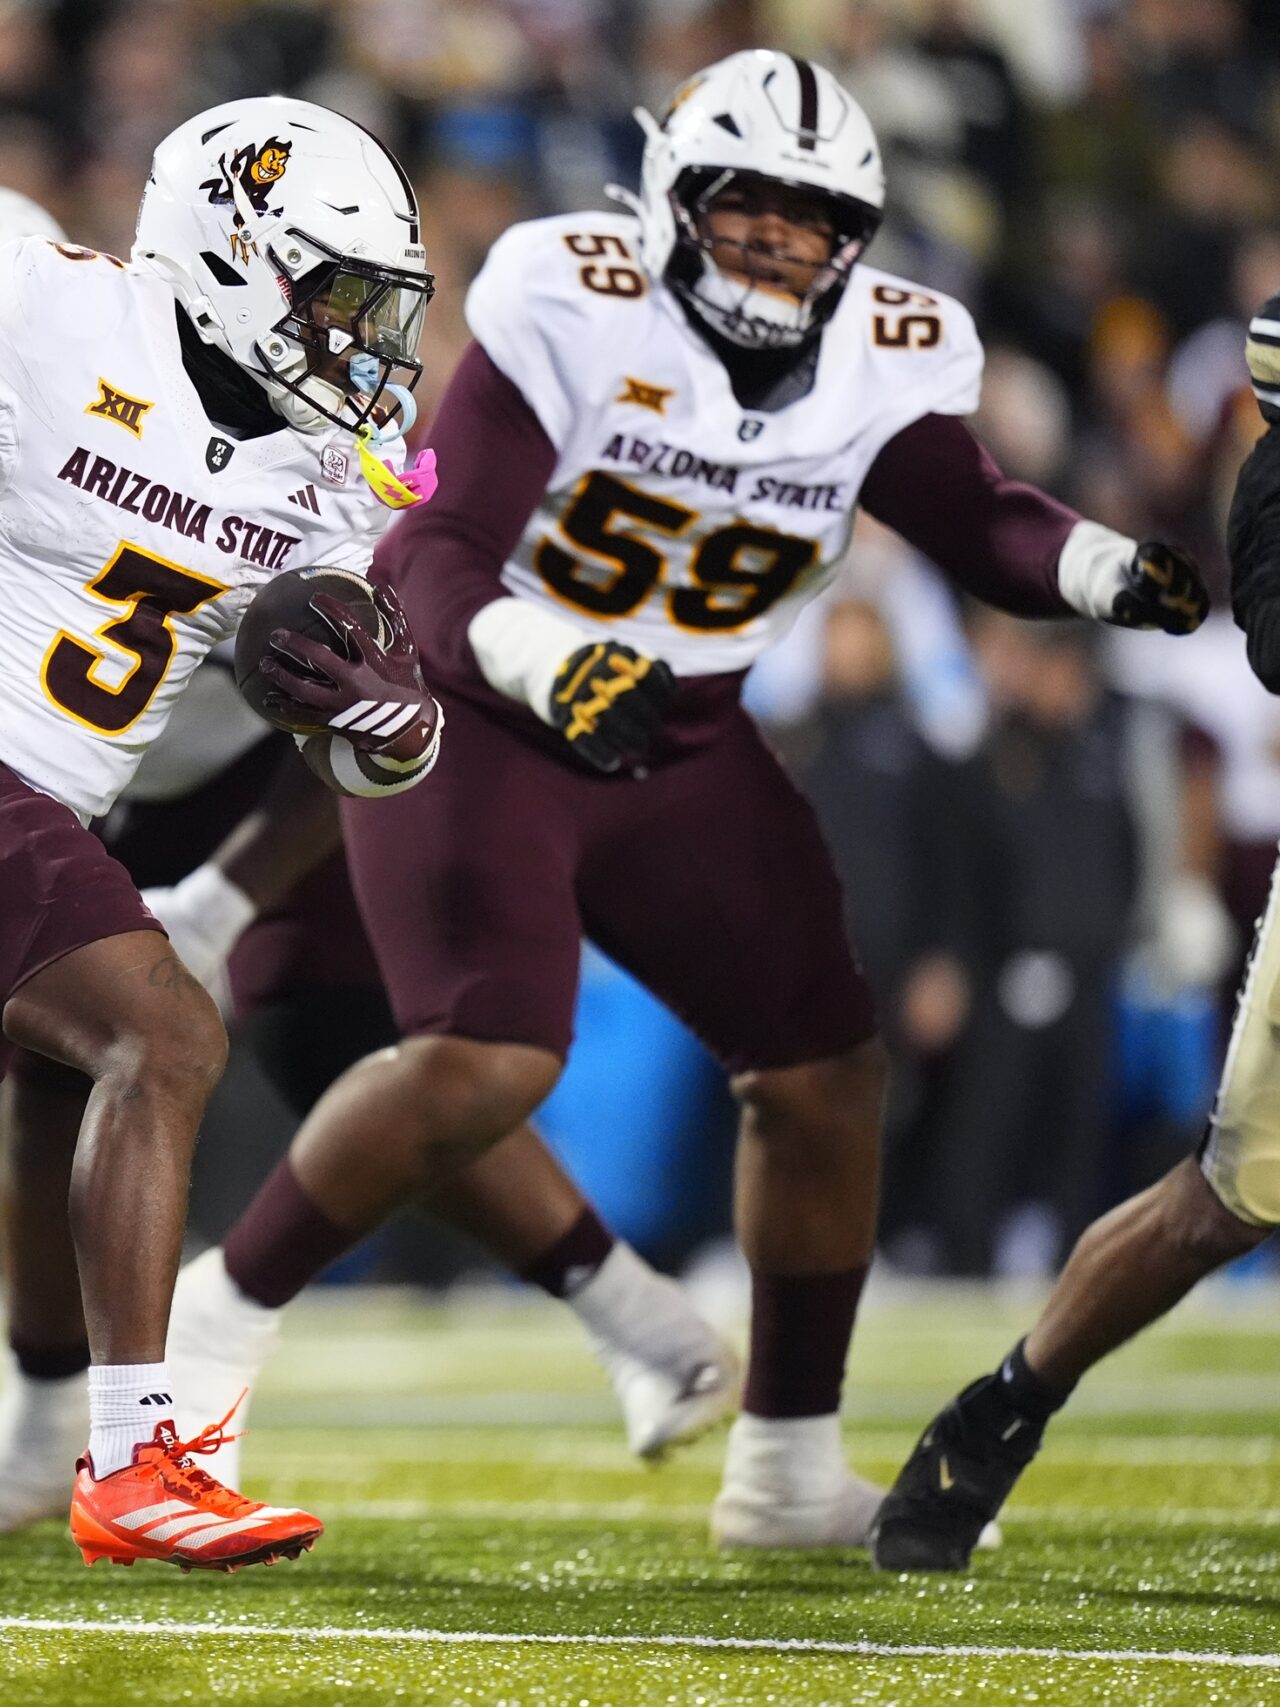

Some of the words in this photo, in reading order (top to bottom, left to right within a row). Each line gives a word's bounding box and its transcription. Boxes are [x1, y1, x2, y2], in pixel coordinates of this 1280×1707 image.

[563, 232, 645, 300] 59
[871, 284, 942, 349] 59
[86, 379, 153, 439] XII
[57, 447, 213, 543] ARIZONA
[216, 516, 302, 569] STATE
[601, 435, 740, 494] ARZONA
[749, 478, 843, 511] STATE
[533, 469, 822, 635] 59
[40, 539, 231, 736] 3
